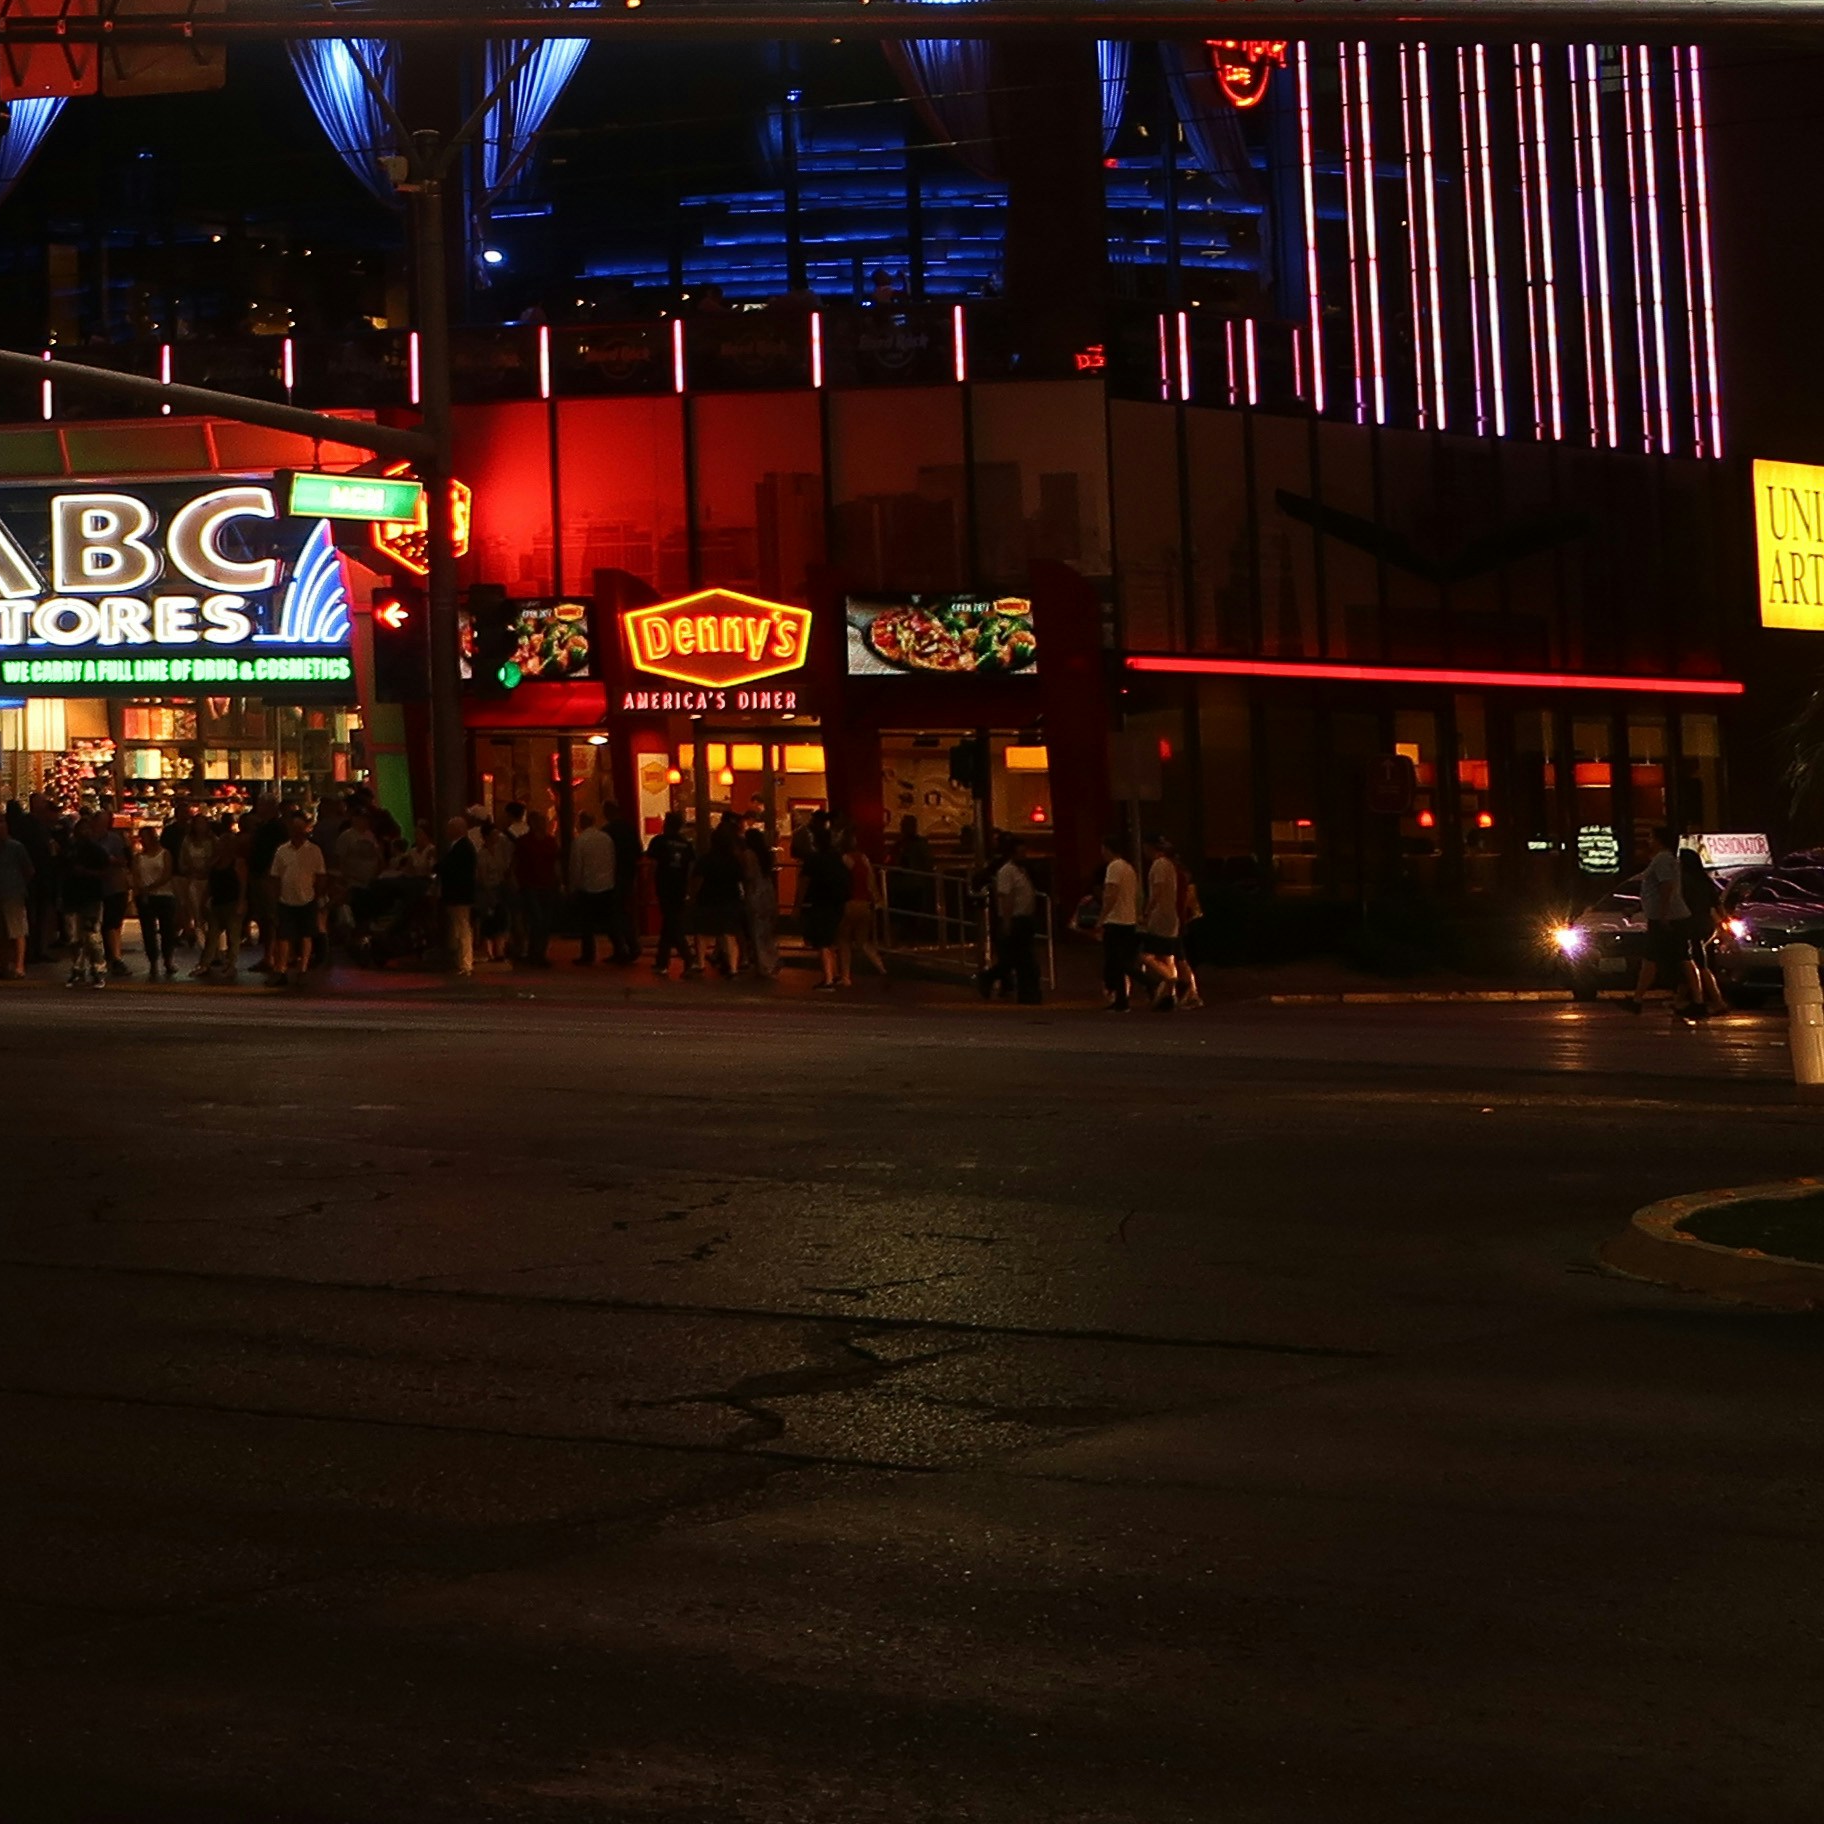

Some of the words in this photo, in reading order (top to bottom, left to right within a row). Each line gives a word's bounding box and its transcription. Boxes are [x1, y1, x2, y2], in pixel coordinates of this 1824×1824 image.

[1767, 486, 1824, 542] UNI
[1767, 549, 1824, 606] ART
[642, 611, 799, 662] Denny's
[2, 661, 29, 683] WE
[30, 660, 82, 682] CARRY
[83, 660, 97, 682] A
[98, 660, 133, 682] FULL
[134, 659, 169, 681] LINE
[170, 659, 192, 681] OF
[193, 659, 238, 681] DRUG
[239, 660, 254, 680] &
[255, 657, 351, 680] COSMETICS
[623, 691, 726, 710] AMERICA'S
[738, 691, 797, 710] DINER
